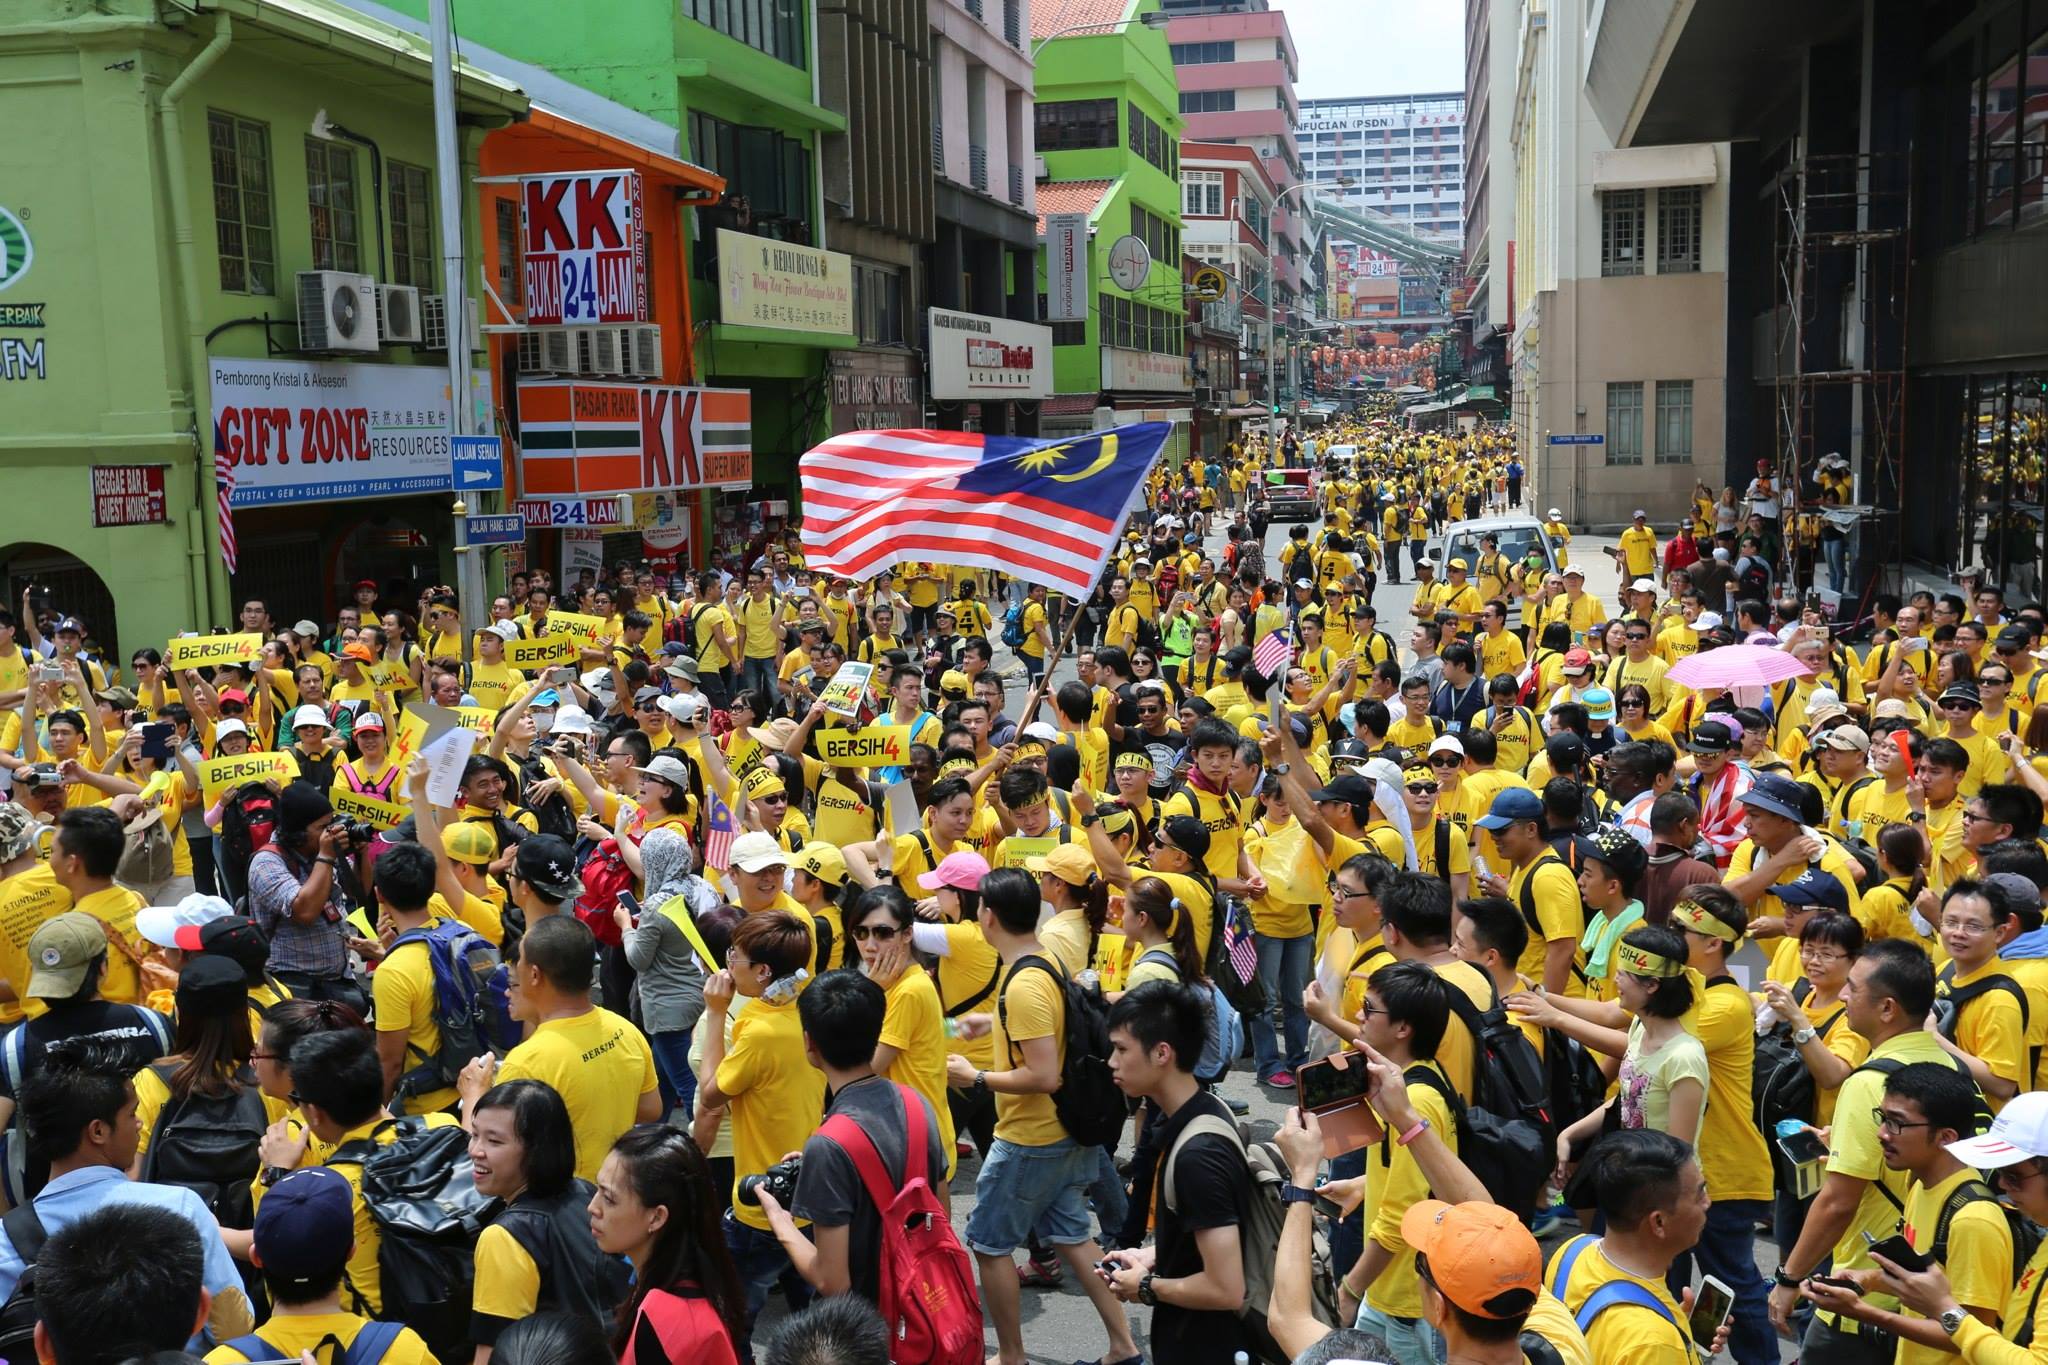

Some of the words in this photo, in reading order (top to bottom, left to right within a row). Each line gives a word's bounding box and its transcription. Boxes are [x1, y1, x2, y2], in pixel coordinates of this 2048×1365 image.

[633, 177, 640, 201] KK
[527, 177, 624, 252] KK
[633, 207, 643, 267] SUPER
[773, 248, 795, 274] KEDAI
[1372, 262, 1383, 274] 24
[528, 260, 561, 318] BUKA
[563, 257, 596, 318] 24
[600, 256, 633, 315] JAM
[636, 275, 645, 320] MART
[0, 338, 46, 380] FM
[216, 370, 271, 390] Pemborong
[273, 372, 301, 387] Kristal
[304, 373, 310, 387] &
[312, 373, 348, 388] Aksesori
[575, 391, 609, 416] PASAR
[611, 394, 636, 416] RAYA
[220, 406, 292, 467] GIFT
[300, 407, 371, 464] ZONE
[373, 436, 448, 457] RESOURCES
[641, 389, 700, 487] KK
[453, 443, 476, 460] LALUAN
[478, 443, 500, 459] SEHALA
[704, 455, 729, 479] SUPER
[731, 454, 750, 477] MART
[95, 469, 125, 495] REGGAE
[127, 469, 142, 494] BAR
[144, 469, 149, 494] &
[229, 491, 266, 502] CRYSTAL
[278, 489, 294, 499] GEM
[306, 486, 330, 497] GLASS
[334, 484, 357, 494] BEADS
[369, 480, 391, 490] PEARL
[401, 479, 444, 489] ACCESSORIES
[100, 497, 123, 523] GUEST
[127, 496, 150, 521] HOUSE
[518, 503, 550, 524] BUKA
[552, 502, 585, 525] 24
[589, 501, 620, 522] JAM
[470, 519, 488, 533] JALAN
[489, 518, 504, 532] HANG
[506, 518, 519, 532] LEKIR
[179, 640, 252, 660] BERSIH4
[515, 639, 575, 662] BERSIH4
[472, 680, 508, 692] BERSIH4
[827, 735, 900, 761] BERSIH4
[211, 757, 289, 783] BERSIH4
[337, 797, 401, 827] BERSIH4
[820, 795, 865, 815] BERSIH4
[806, 857, 821, 874] 98
[10, 888, 51, 910] TUNTUTAN
[1620, 946, 1648, 970] SIH4
[582, 1040, 615, 1062] BERSIH
